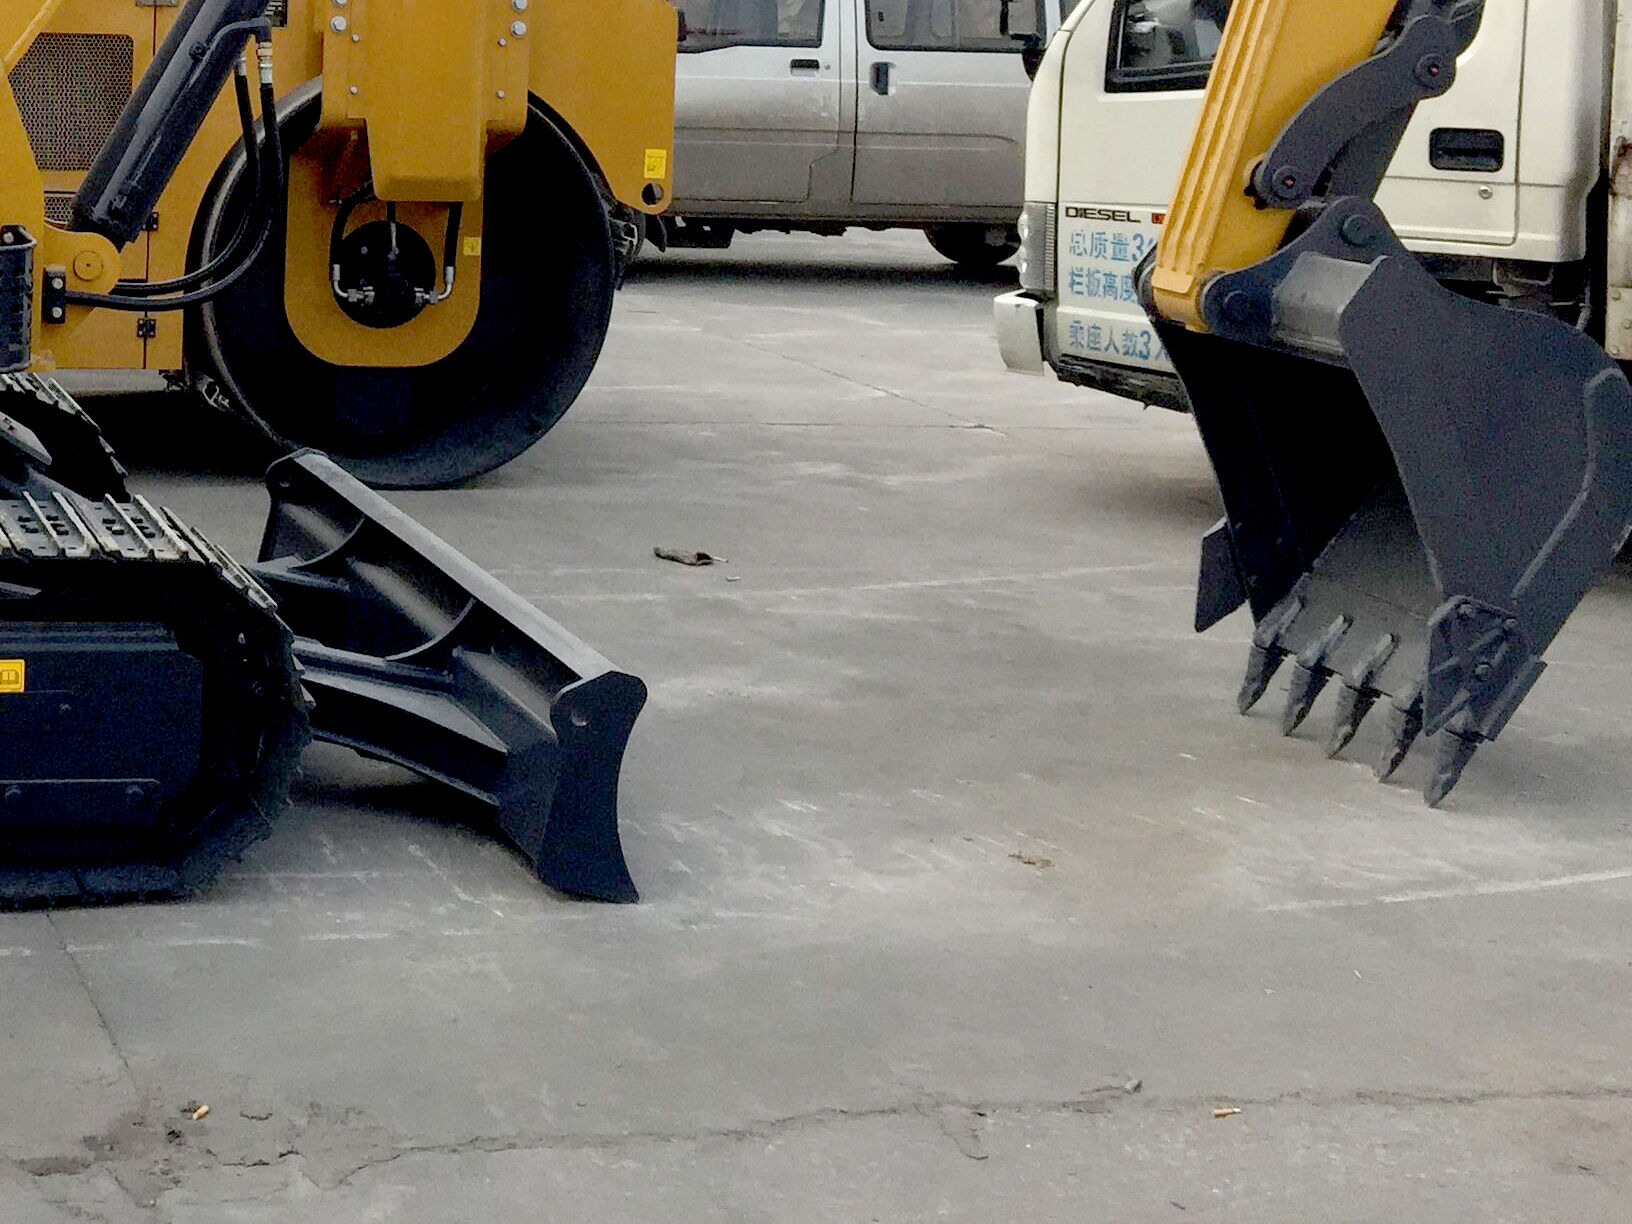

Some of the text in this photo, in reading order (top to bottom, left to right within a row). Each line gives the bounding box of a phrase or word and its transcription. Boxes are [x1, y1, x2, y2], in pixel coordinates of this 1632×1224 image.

[1065, 206, 1142, 223] DIESEL
[1069, 229, 1154, 261] 总质量3
